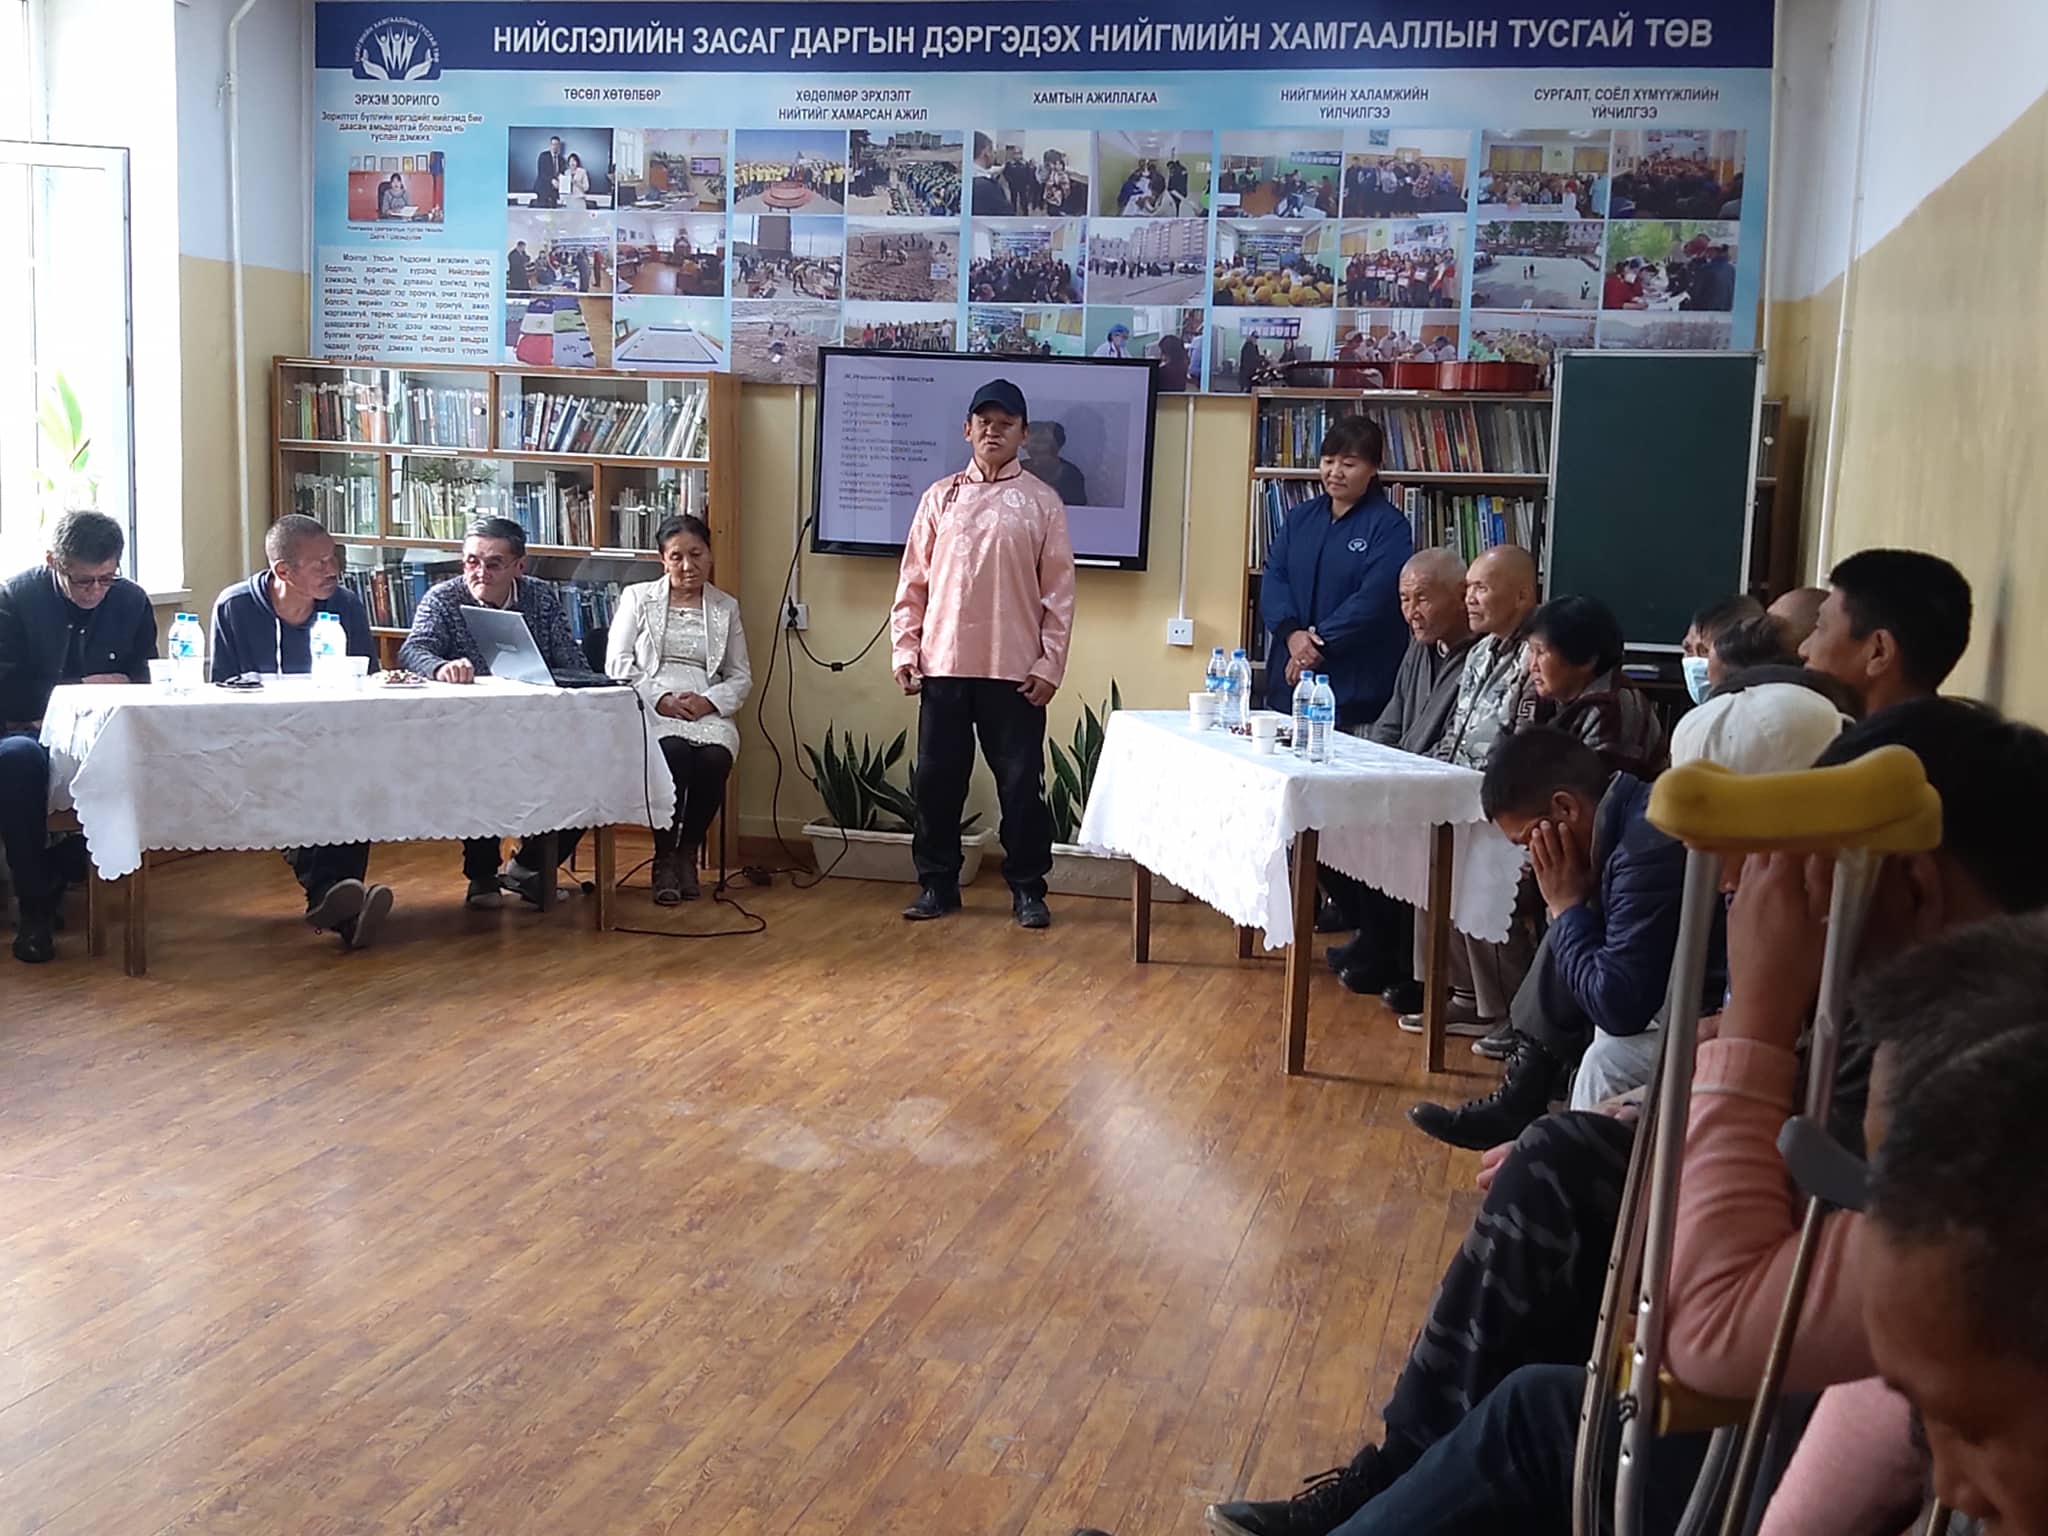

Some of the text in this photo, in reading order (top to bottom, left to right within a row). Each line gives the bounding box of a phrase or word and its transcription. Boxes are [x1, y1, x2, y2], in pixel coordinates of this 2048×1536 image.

[493, 12, 1712, 58] НИЙСЛЭЛИЙН ЗАСАГ ДАРГЫН ДЭРГЭДЭХ НИЙГМИЙН ХАМГААЛЛЫН ТУСГАЙ ТӨВ
[354, 94, 440, 106] ЭРХЭМ ЗОРИЛГО
[564, 88, 662, 101] ТӨСӨЛ ХӨТӨЛБӨР
[796, 89, 912, 104] ХӨДӨЛМӨР ЭРХЛЭЛТ
[1033, 91, 1158, 105] ХАМТЫН АЖИЛЛАГАА
[1280, 86, 1430, 101] НИЙГМИЙН ХАЛАМЖИЙН
[1533, 87, 1720, 102] СУРГАЛТ, СОЁЛ ХҮМҮҮЖЛИЙН
[778, 107, 928, 121] НИЙТИЙГ ХАМАРСАН АЖИЛ
